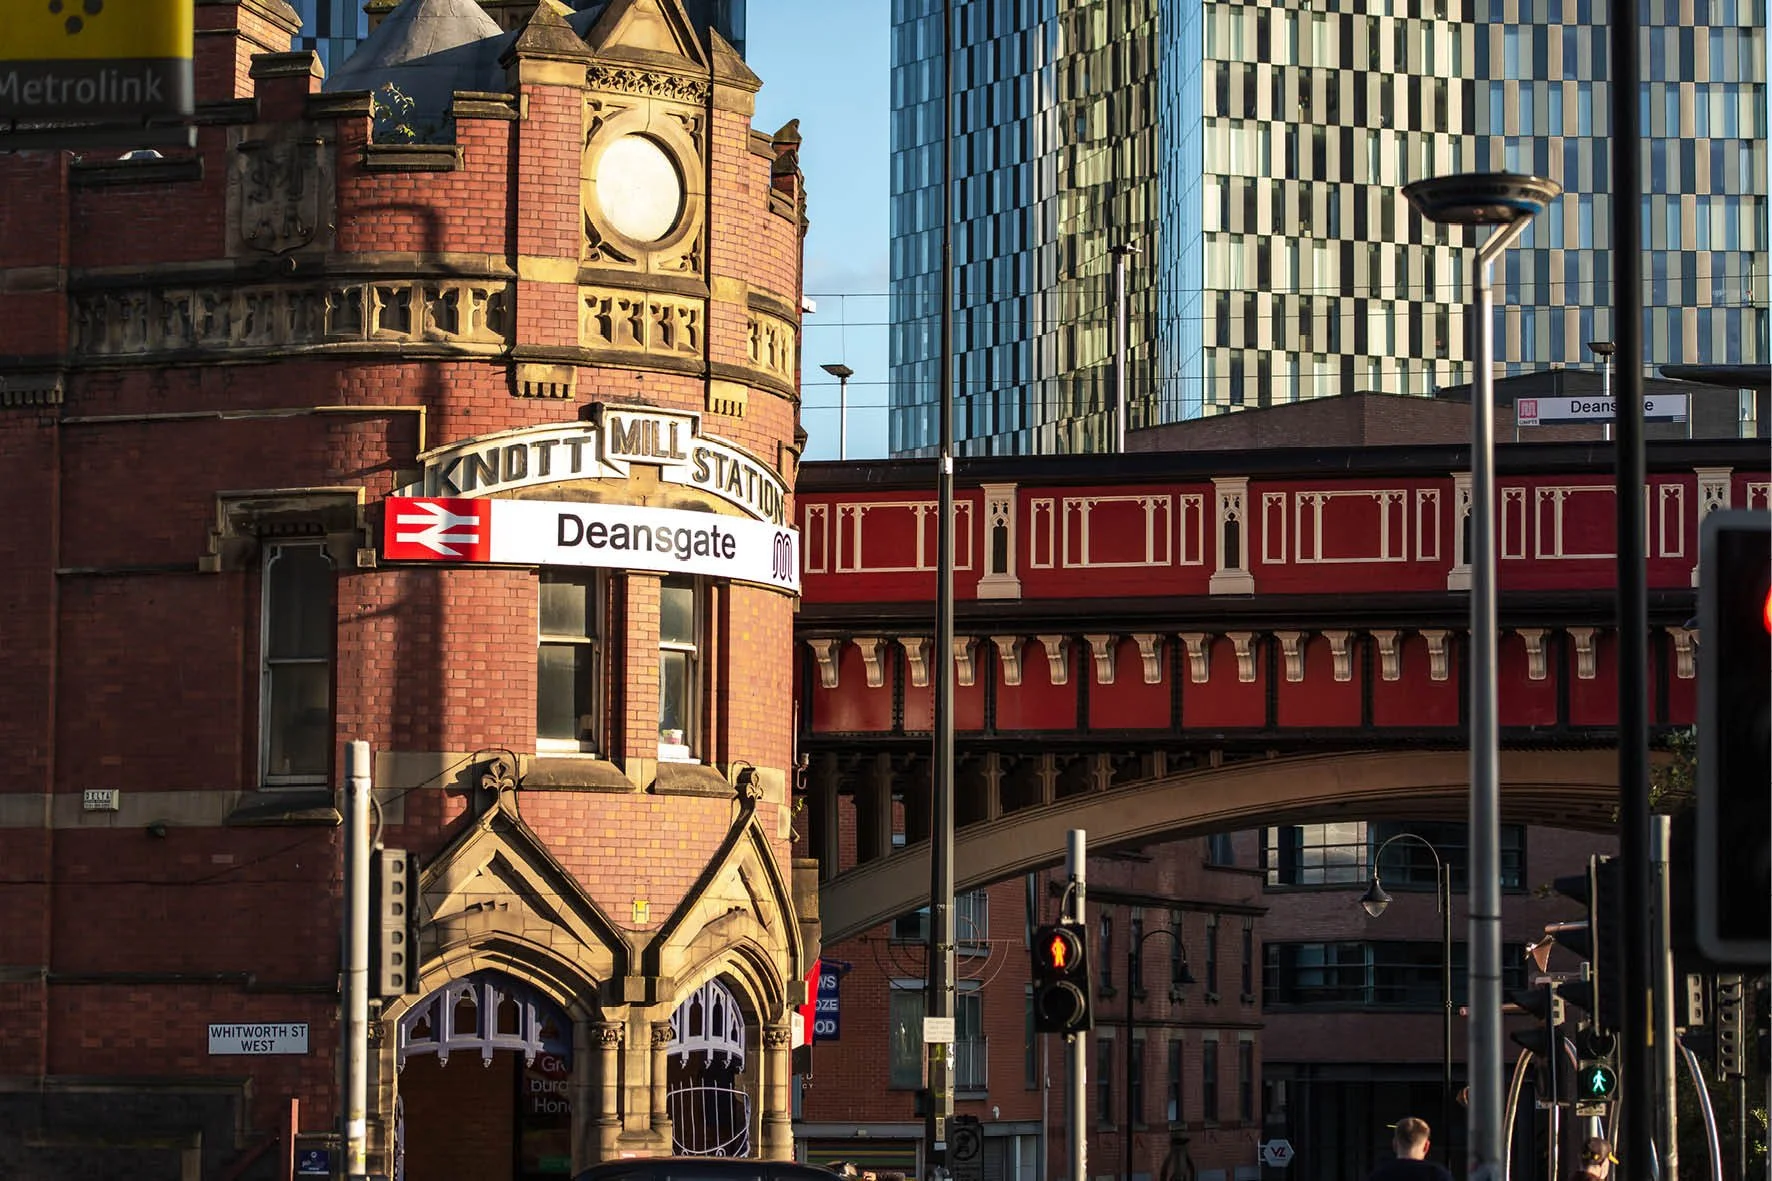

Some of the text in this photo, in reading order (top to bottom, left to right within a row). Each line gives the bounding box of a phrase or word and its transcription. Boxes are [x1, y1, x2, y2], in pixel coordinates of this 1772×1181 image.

[0, 68, 164, 105] Metrolink
[1571, 399, 1654, 413] Deanse
[425, 416, 786, 527] KNOTT MILL STATION
[557, 513, 737, 562] Deansgate
[211, 1026, 306, 1038] WHITWORTH ST
[241, 1040, 275, 1052] WEST
